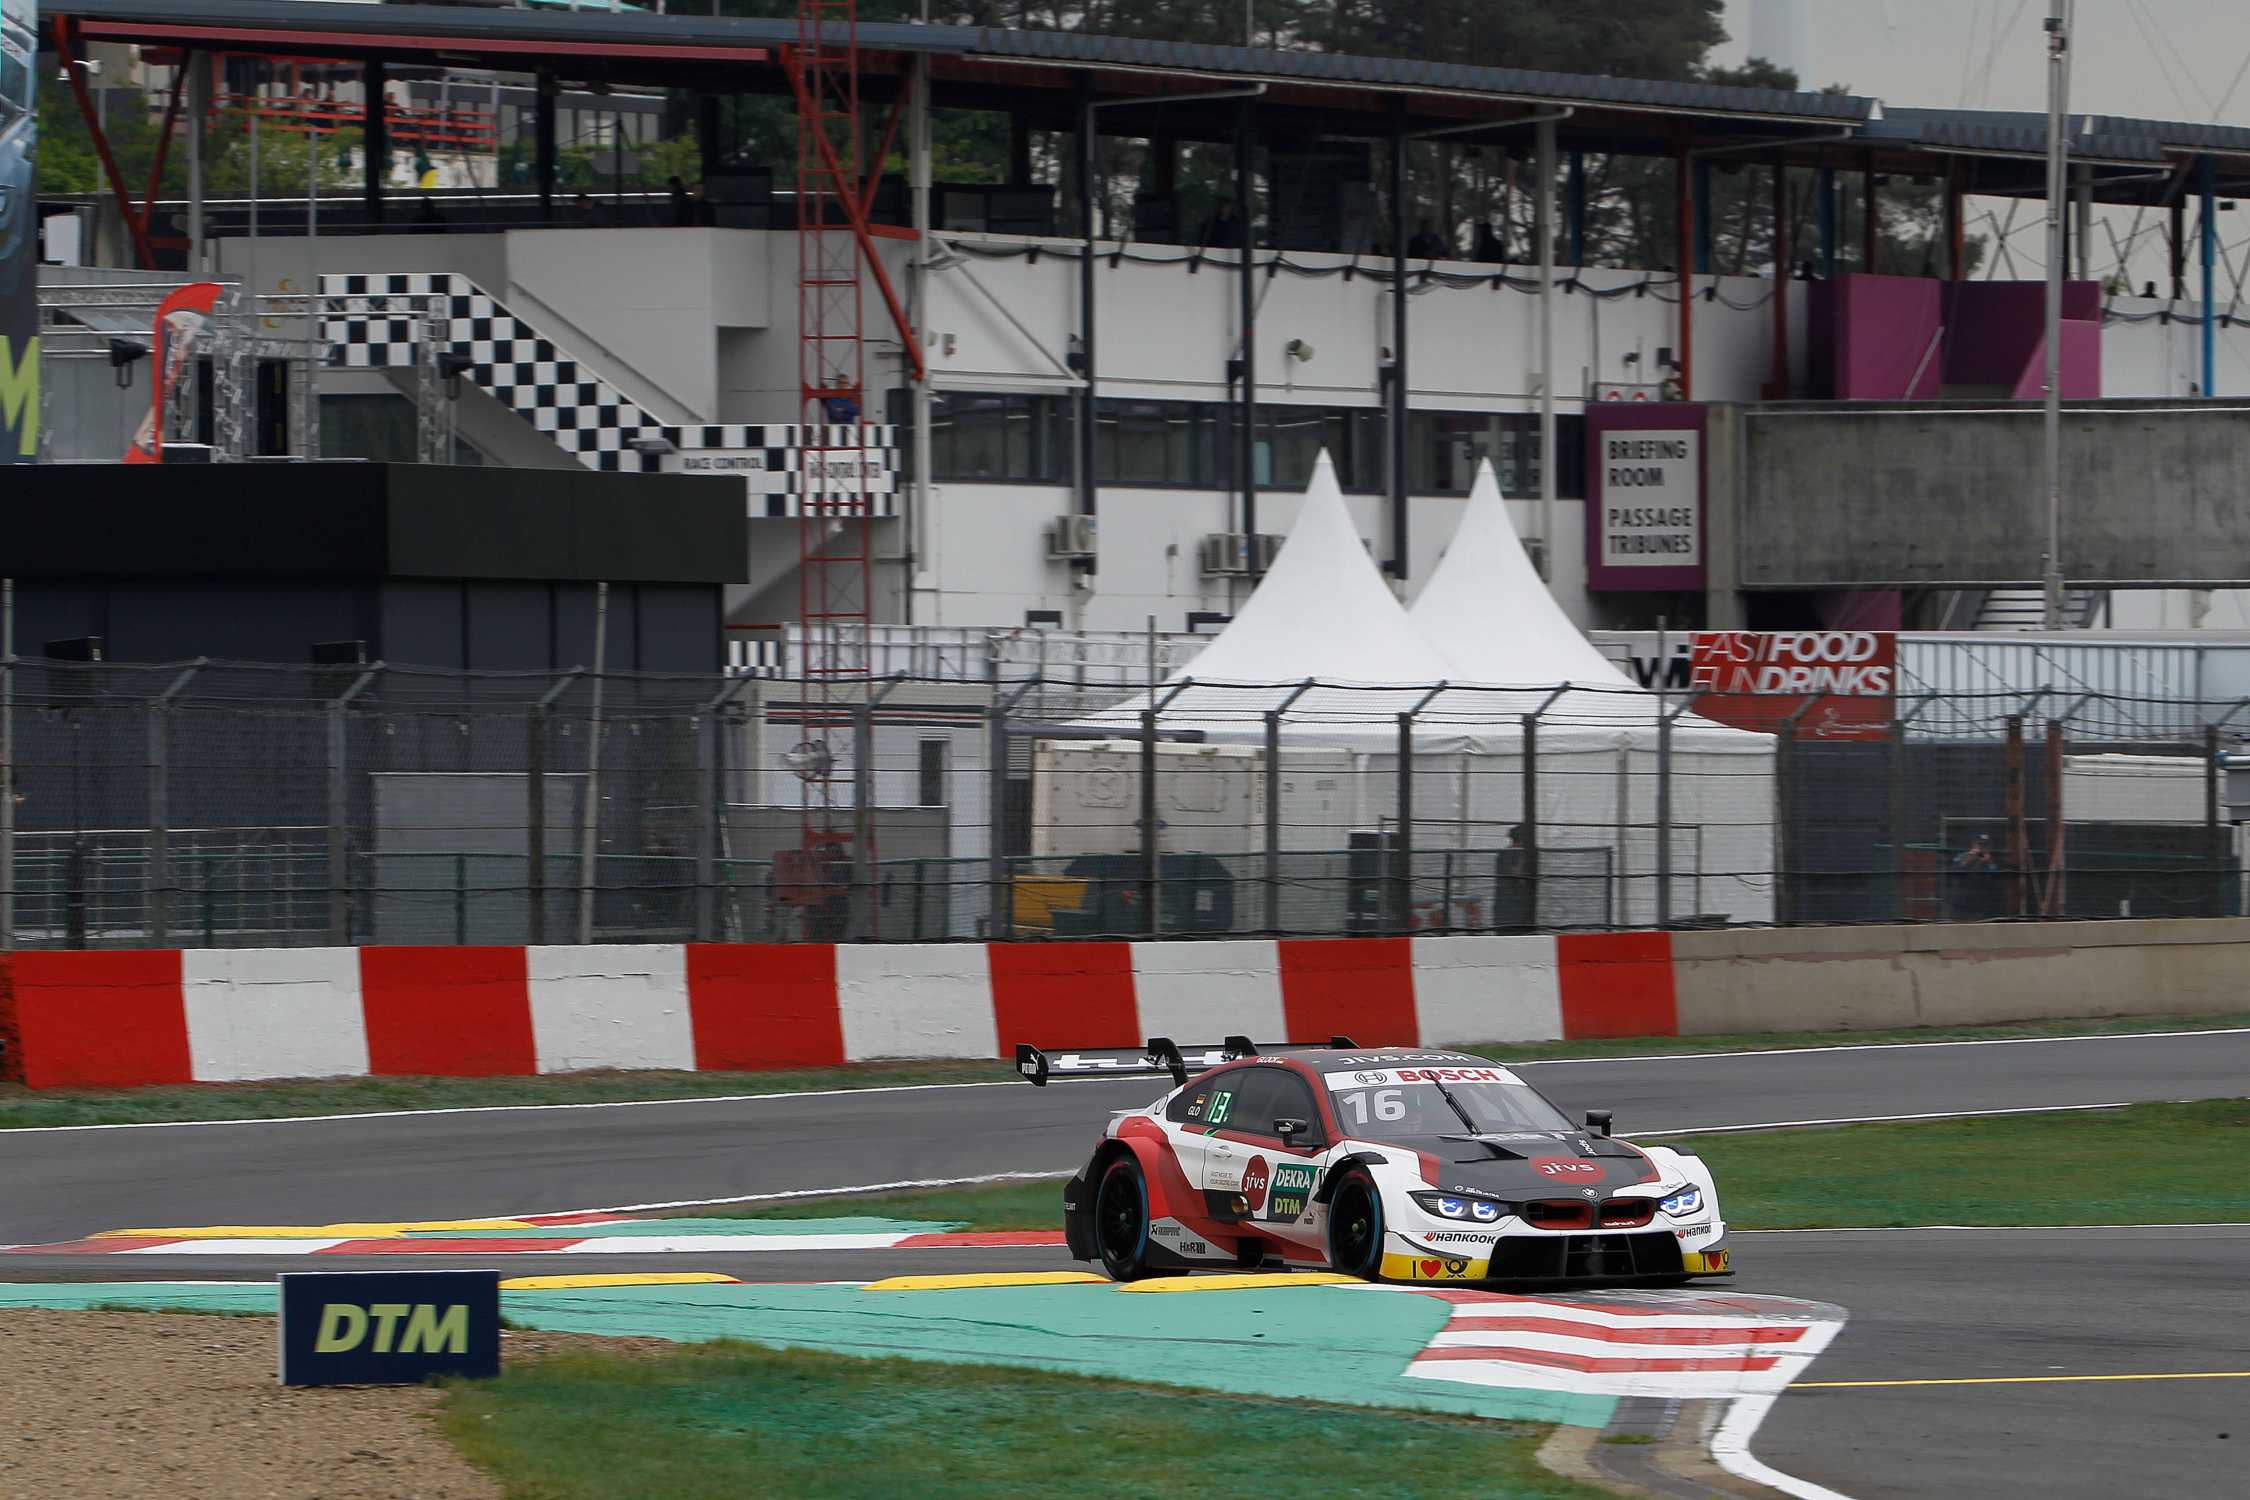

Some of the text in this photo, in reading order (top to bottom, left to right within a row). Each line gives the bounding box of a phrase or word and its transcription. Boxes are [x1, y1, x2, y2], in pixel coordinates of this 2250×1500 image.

[1608, 440, 1688, 460] BRIEFING
[1608, 467, 1665, 487] ROOM
[1608, 508, 1693, 527] PASSAGE
[1608, 535, 1692, 554] TRIBUNES
[1395, 1069, 1500, 1082] BOSCH
[1187, 1105, 1200, 1116] GLO
[1343, 1089, 1406, 1125] 16
[1244, 1172, 1265, 1191] jivs
[1276, 1169, 1310, 1188] DEKRA
[1275, 1198, 1300, 1214] DTM
[314, 1303, 470, 1354] DTM
